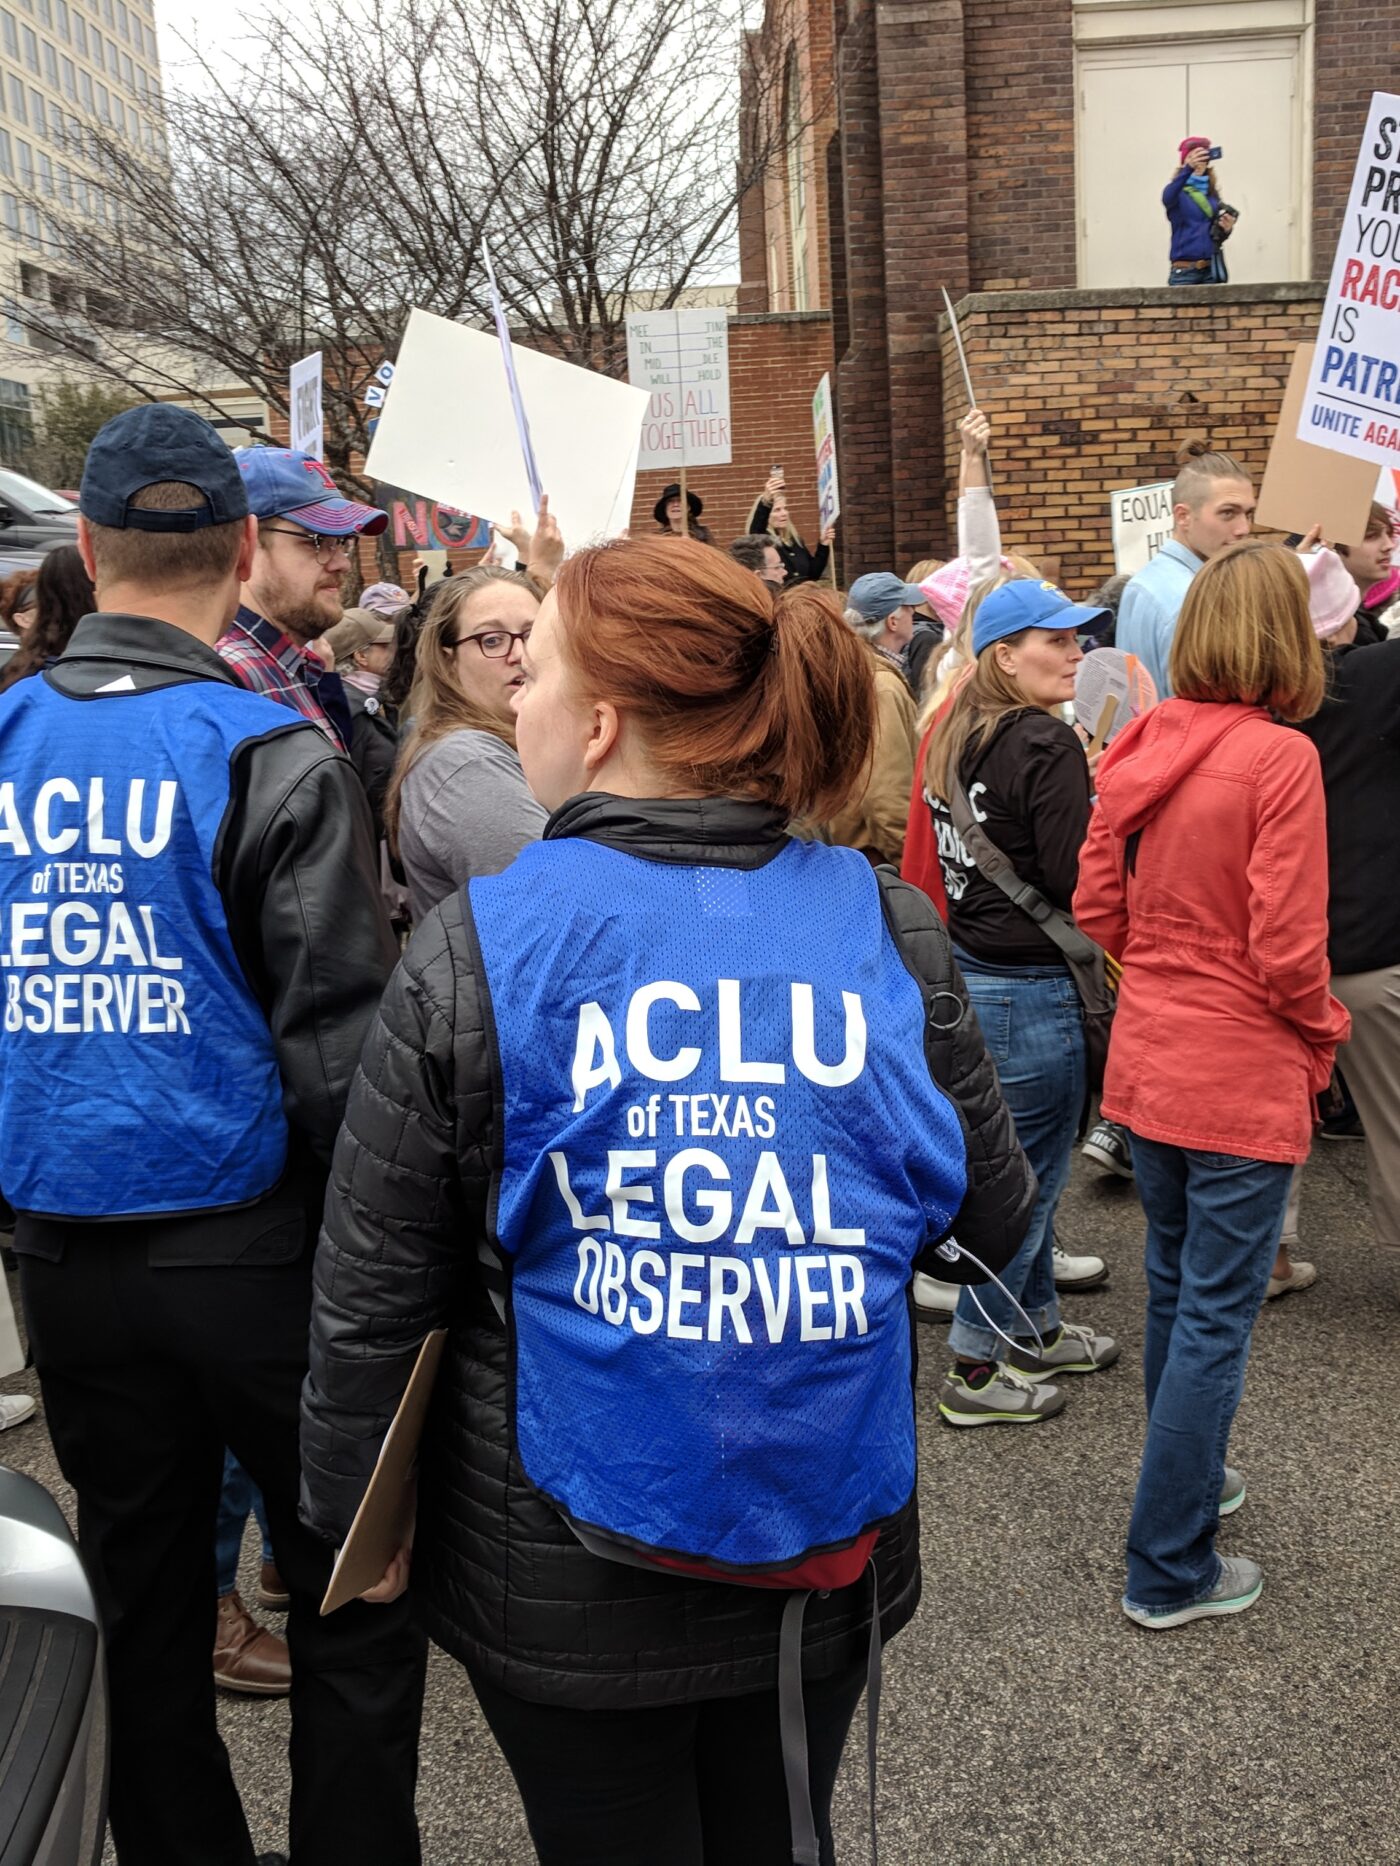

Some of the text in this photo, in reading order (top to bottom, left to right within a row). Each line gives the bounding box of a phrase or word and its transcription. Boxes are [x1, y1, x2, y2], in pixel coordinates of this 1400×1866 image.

[1374, 117, 1400, 163] S
[1330, 304, 1359, 343] IS
[640, 336, 724, 354] IN THE
[650, 369, 721, 384] WILL HOLD
[650, 389, 719, 418] US ALL
[1312, 404, 1362, 438] UNITE
[1121, 488, 1174, 523] EQUA
[0, 777, 177, 858] ACLU
[31, 862, 124, 894] of TEXAS
[0, 901, 183, 970] EGAL
[572, 979, 867, 1114] ACLU
[627, 1093, 776, 1139] of TEXAS
[548, 1147, 866, 1247] LEGAL
[573, 1236, 868, 1344] OBSERVER
